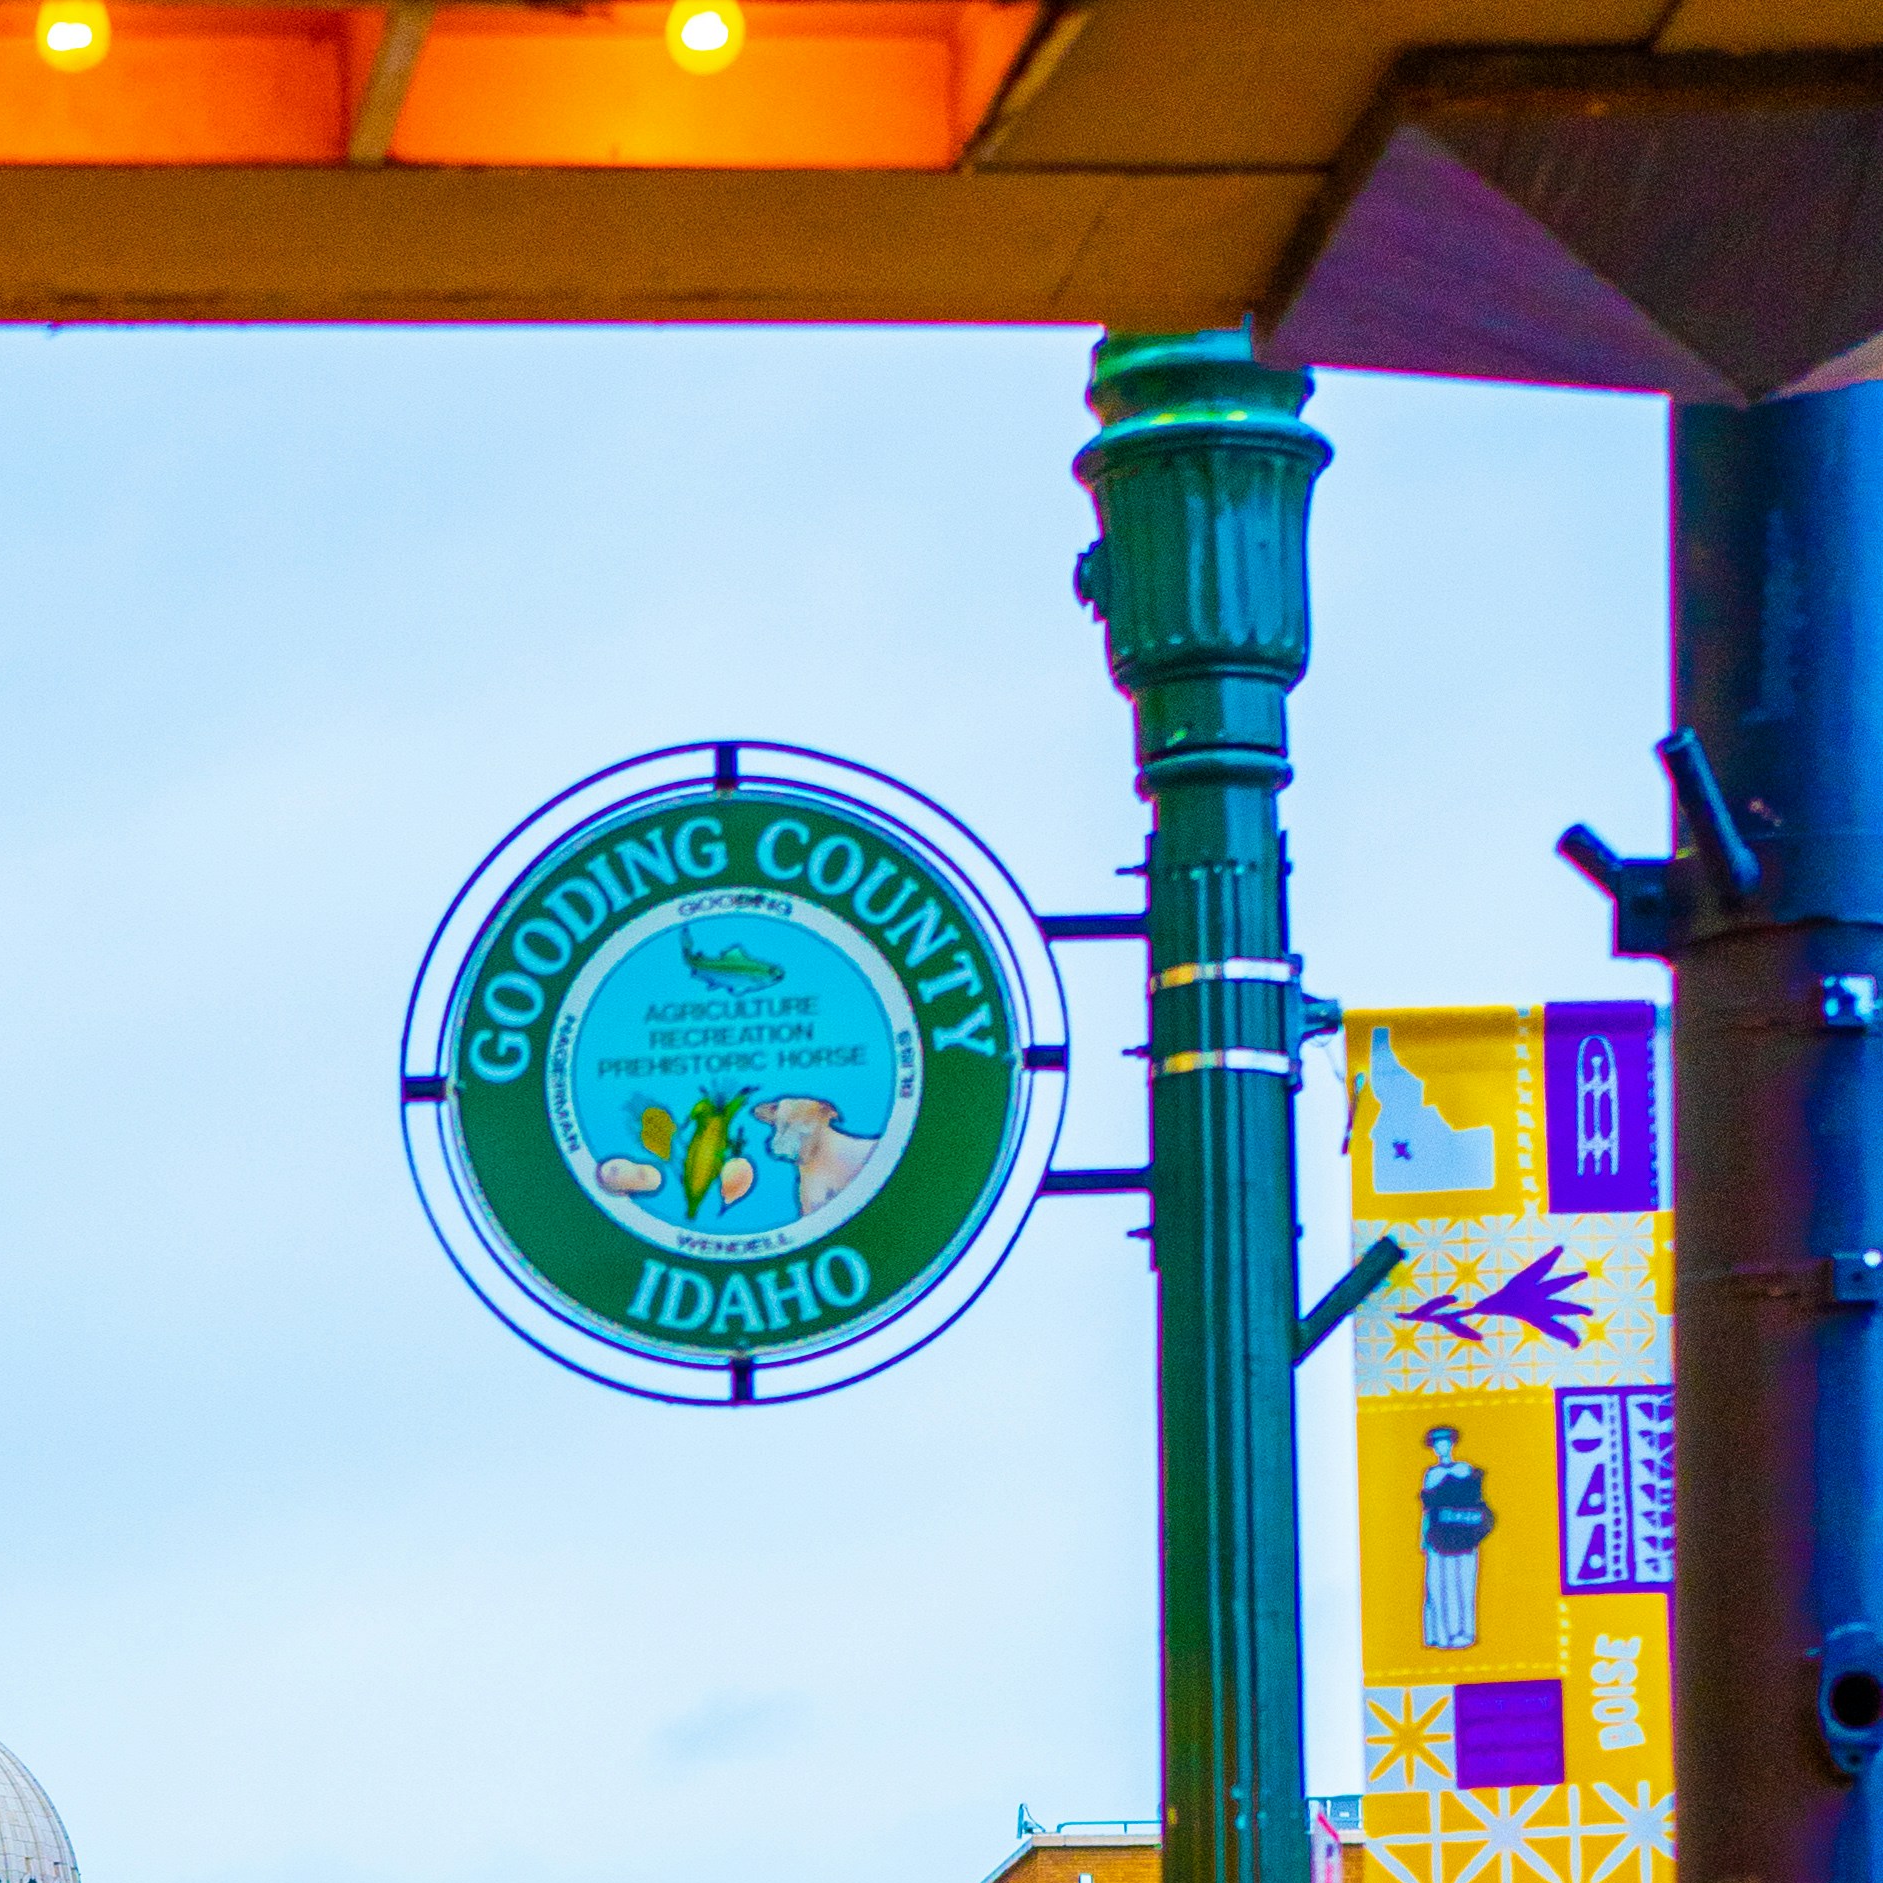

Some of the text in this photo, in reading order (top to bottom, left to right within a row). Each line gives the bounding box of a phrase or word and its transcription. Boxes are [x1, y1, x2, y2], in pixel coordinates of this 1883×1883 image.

[678, 894, 793, 915] GOODING
[469, 815, 996, 1083] GOODING COUNTY
[644, 997, 818, 1023] AGRICULTURE
[649, 1023, 814, 1048] RECREATION
[552, 1014, 581, 1153] HAGERMAN
[598, 1045, 866, 1079] PREHISTORIC HORSE
[627, 1245, 872, 1334] IDAHO
[1590, 1634, 1646, 1751] BOISE
